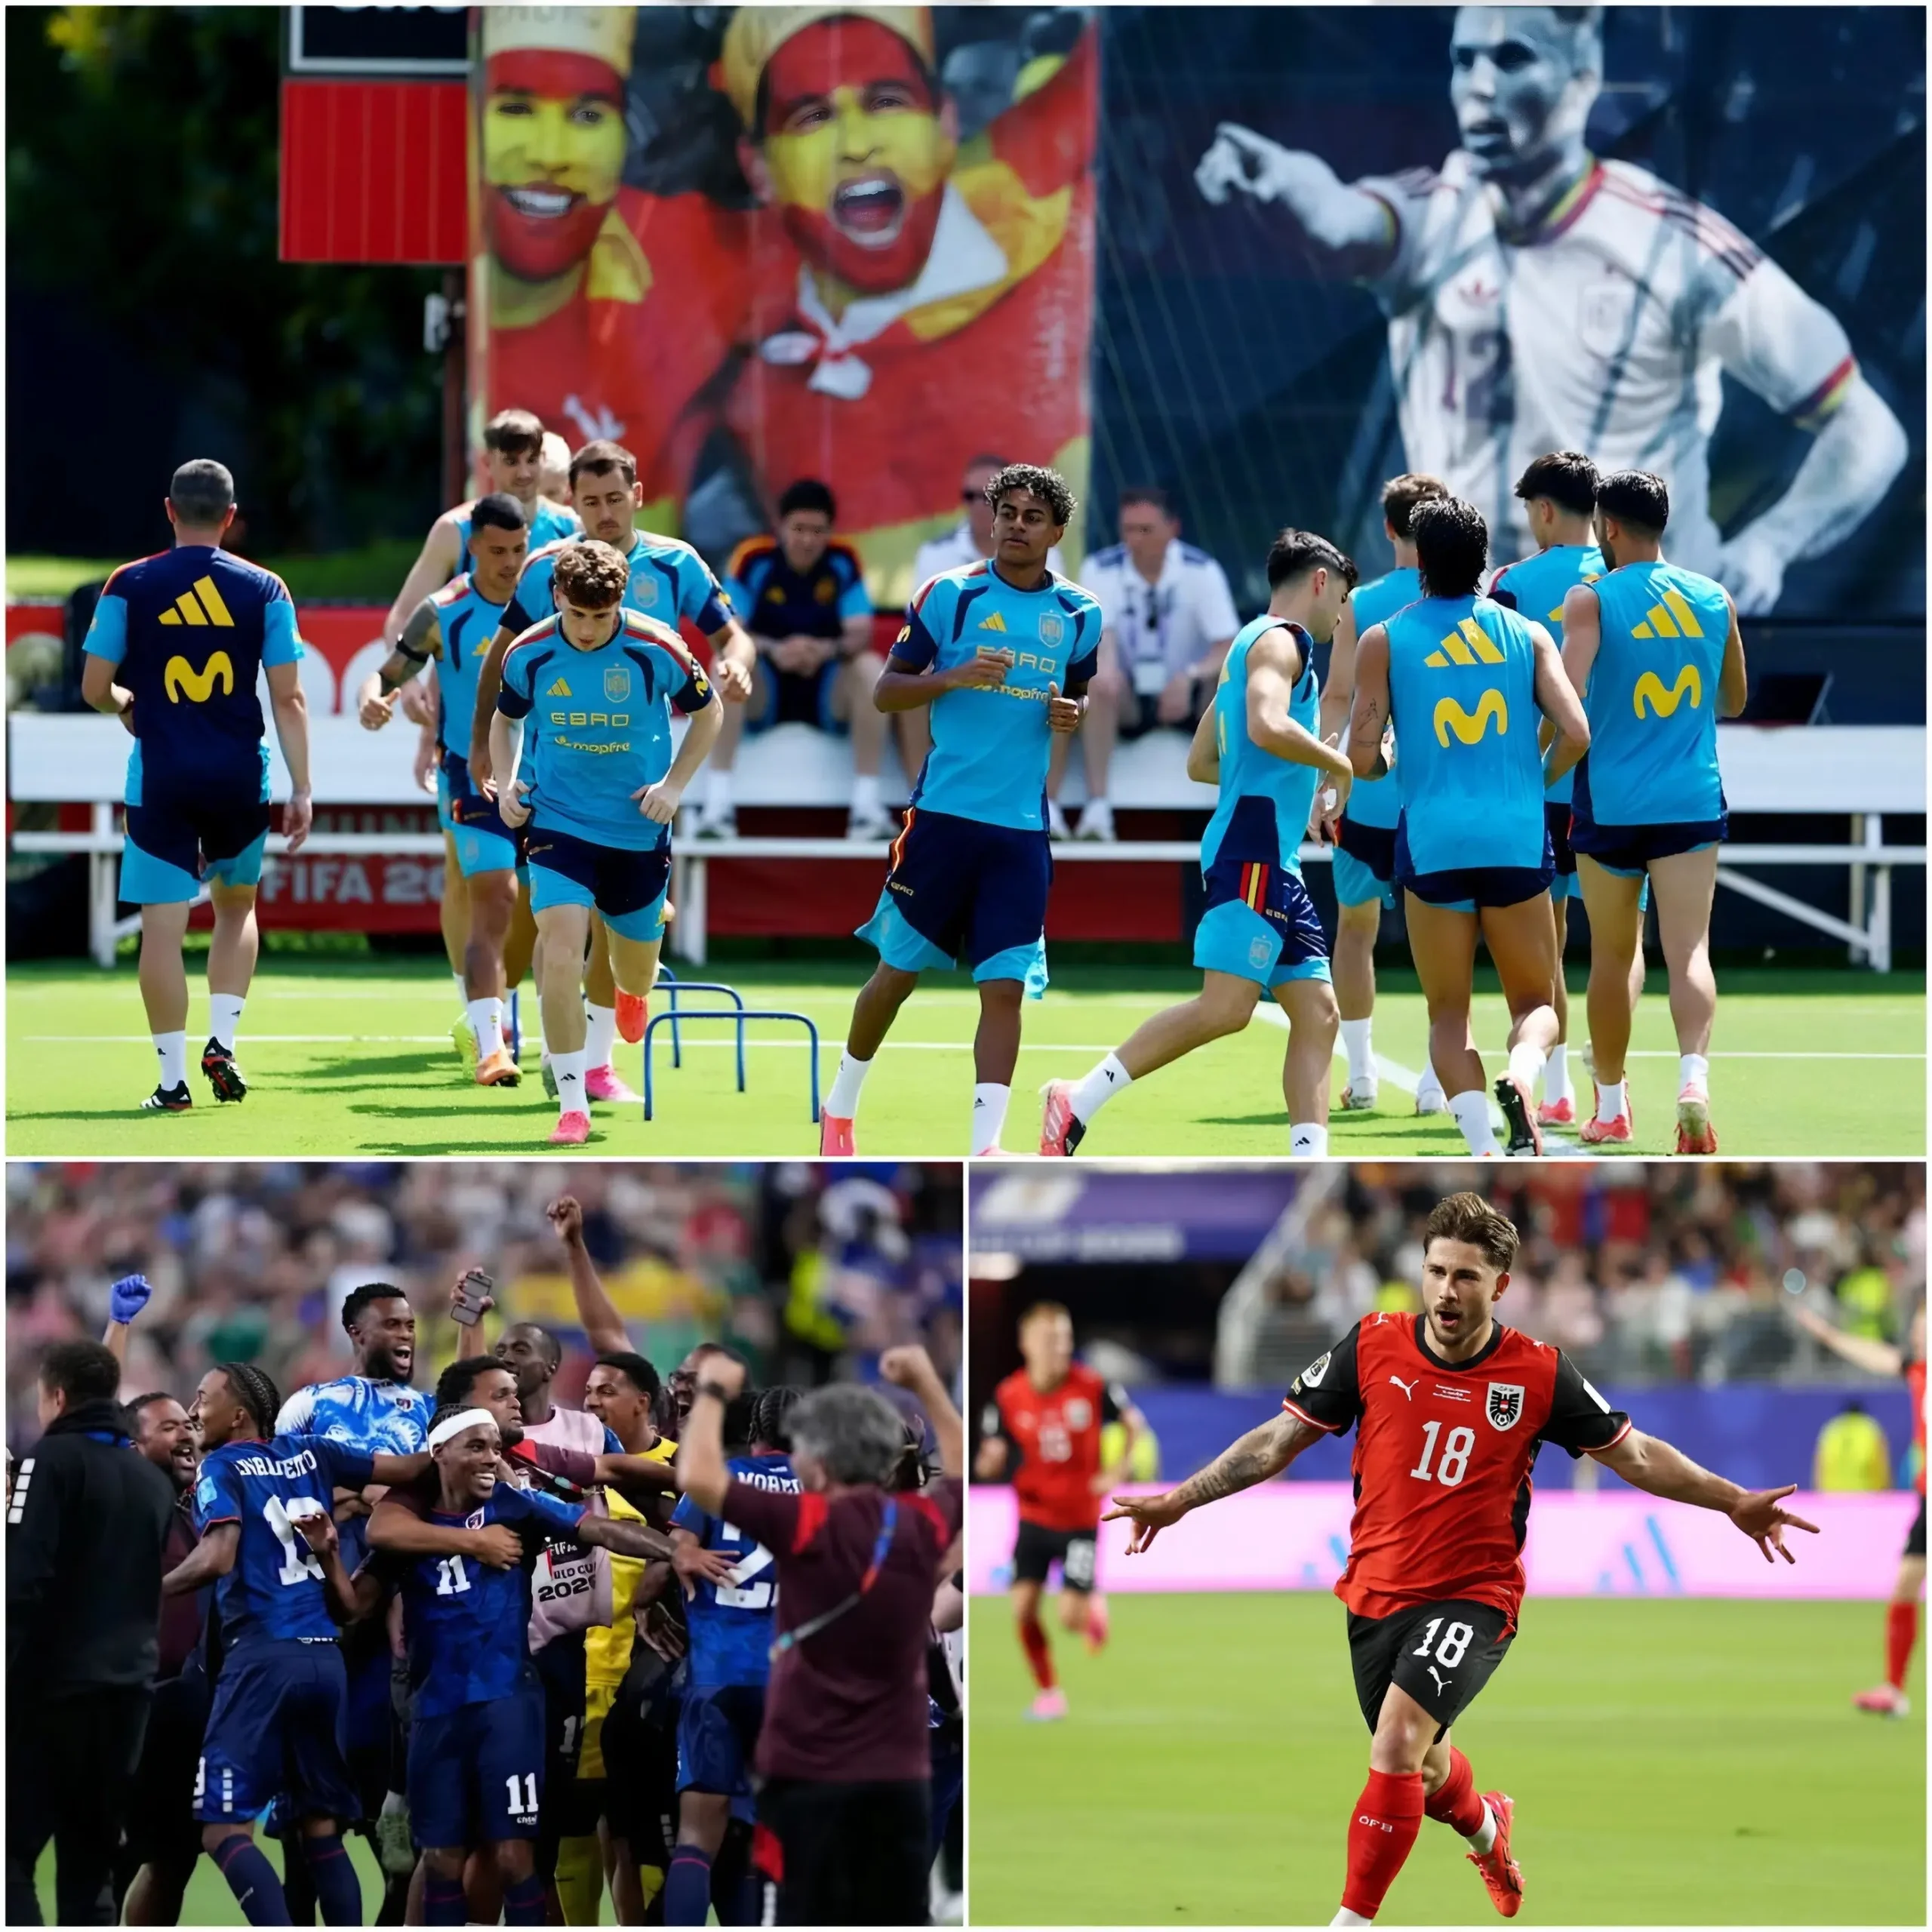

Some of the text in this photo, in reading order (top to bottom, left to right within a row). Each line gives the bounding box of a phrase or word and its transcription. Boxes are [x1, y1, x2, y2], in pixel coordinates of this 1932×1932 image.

[1410, 1420, 1475, 1487] 18
[435, 1554, 472, 1595] 11
[715, 1521, 780, 1609] 2
[1412, 1617, 1475, 1669] 18
[558, 1715, 587, 1753] 1
[506, 1772, 539, 1815] 11
